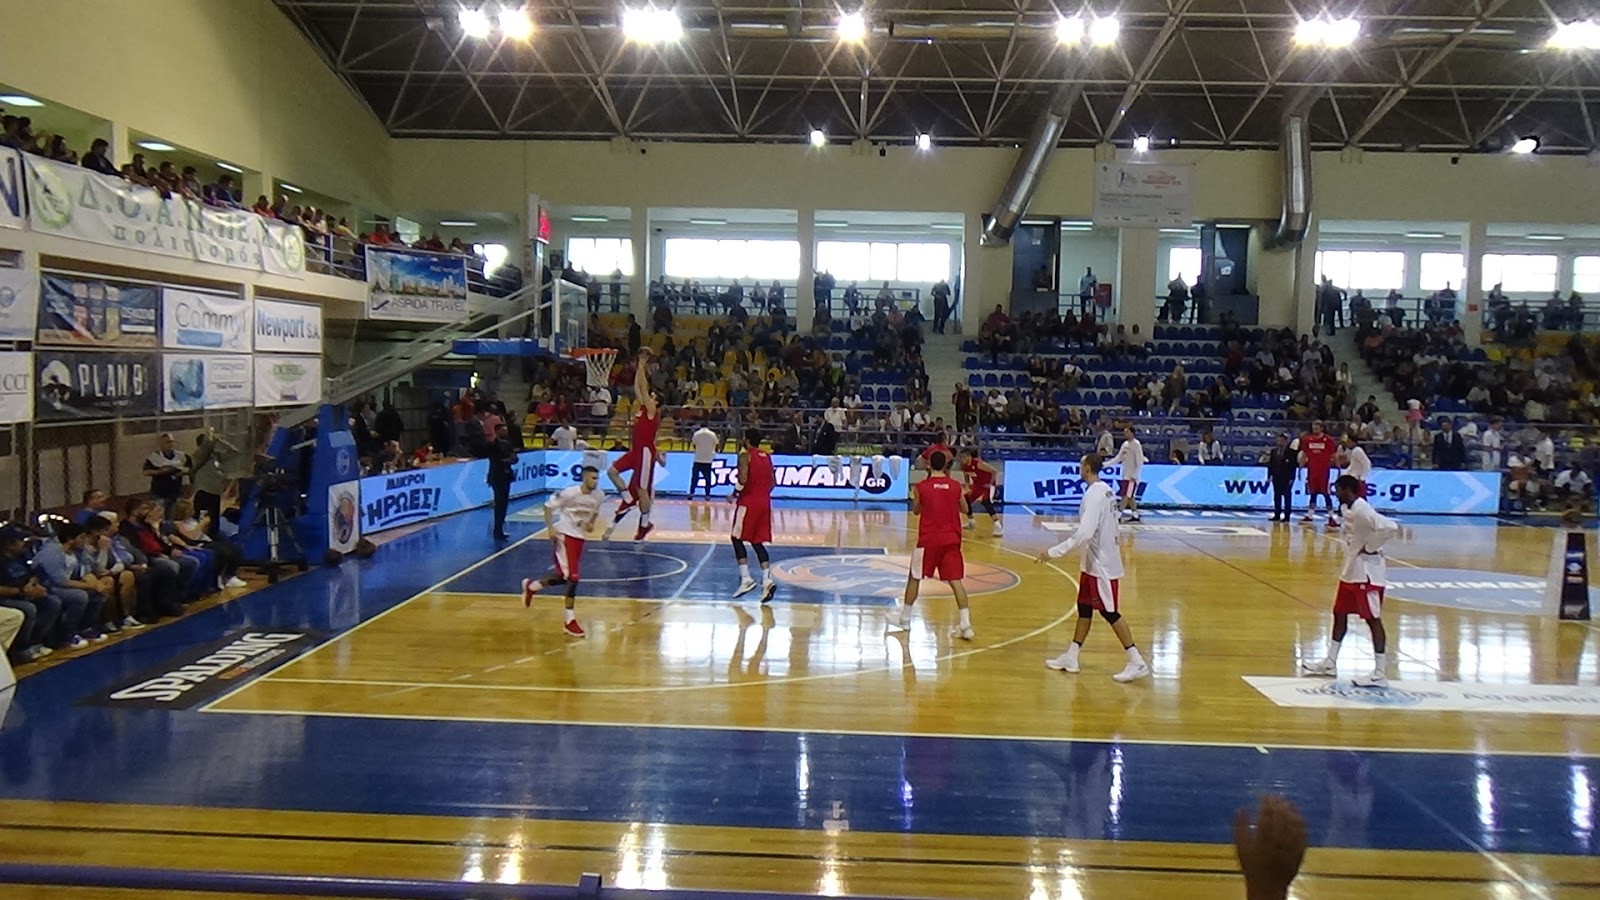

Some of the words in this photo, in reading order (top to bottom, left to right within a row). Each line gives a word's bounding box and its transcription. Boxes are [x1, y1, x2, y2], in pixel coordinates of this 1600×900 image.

[430, 300, 465, 312] TRAVEL
[257, 310, 305, 343] Newport
[78, 364, 128, 397] PLAN
[1060, 465, 1121, 476] ΜΙΟΙ
[367, 488, 441, 526] ΗΡΩΕΣ!
[109, 632, 306, 702] SPALDING
